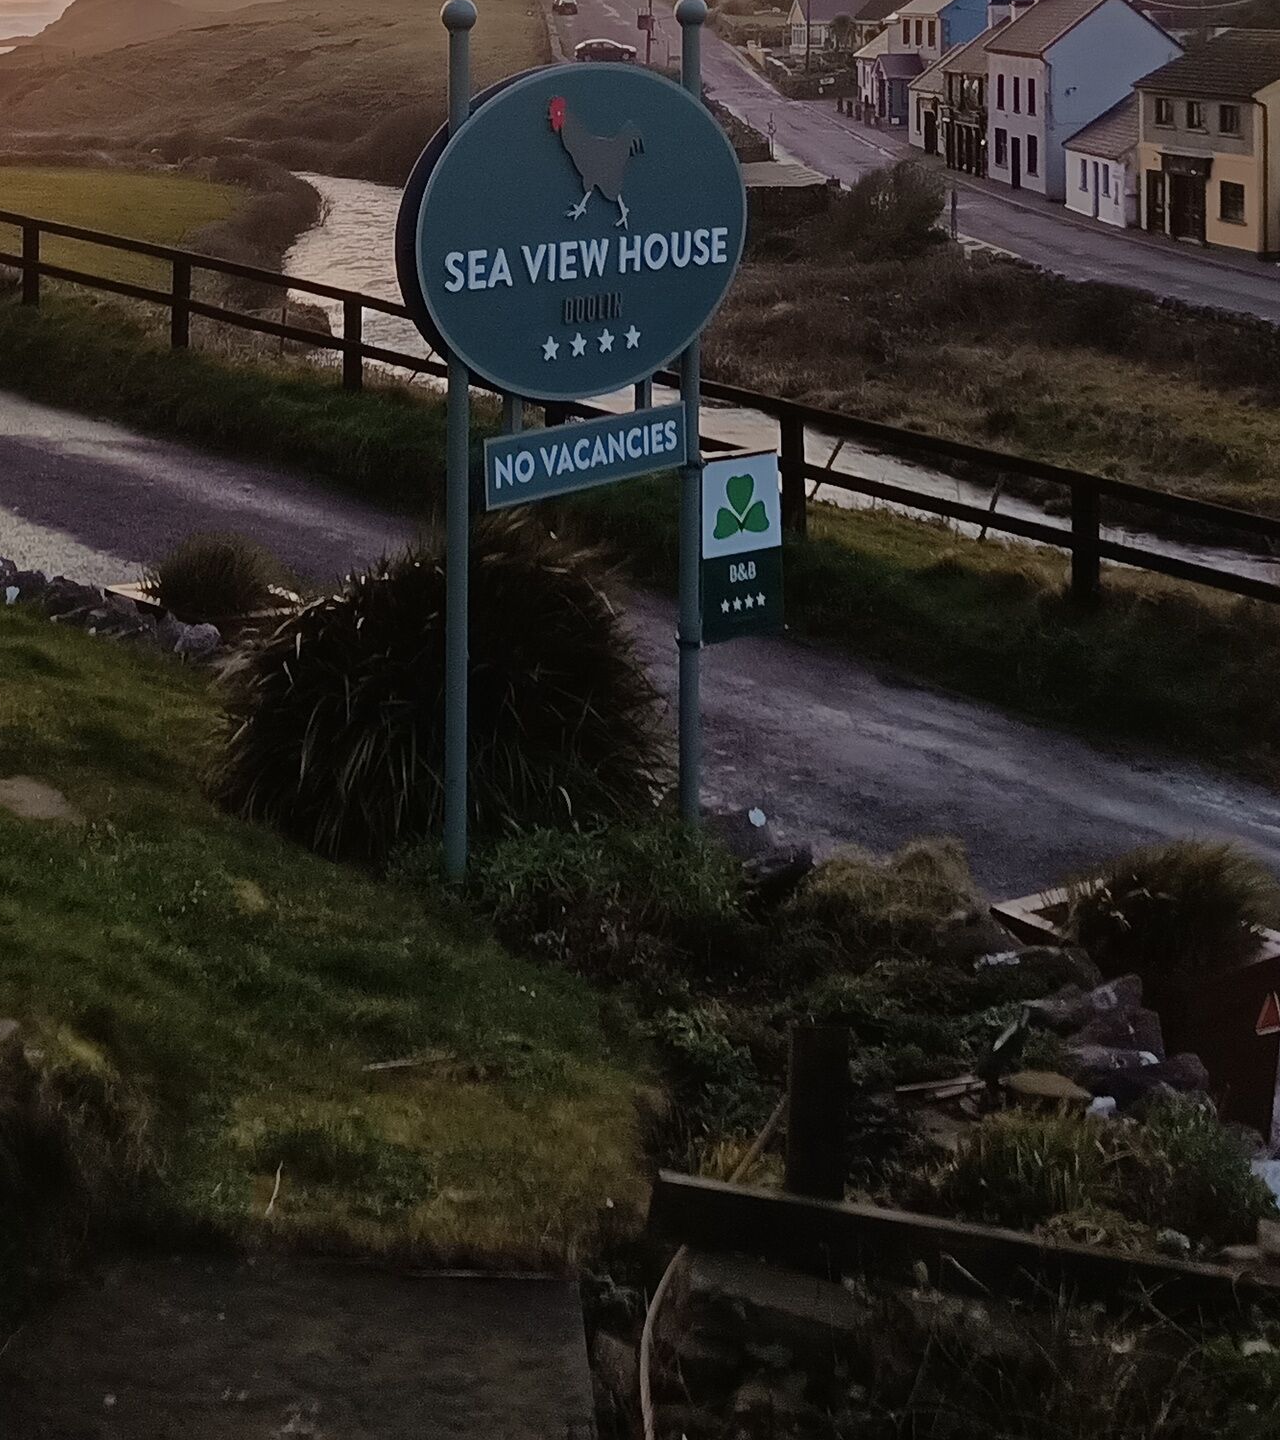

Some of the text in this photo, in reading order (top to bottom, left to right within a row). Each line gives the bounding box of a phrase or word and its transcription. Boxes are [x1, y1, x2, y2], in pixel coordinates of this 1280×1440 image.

[444, 226, 729, 293] SEA VIEW HOUSE
[494, 419, 678, 490] NO VACANCIES
[729, 561, 757, 584] B&B
